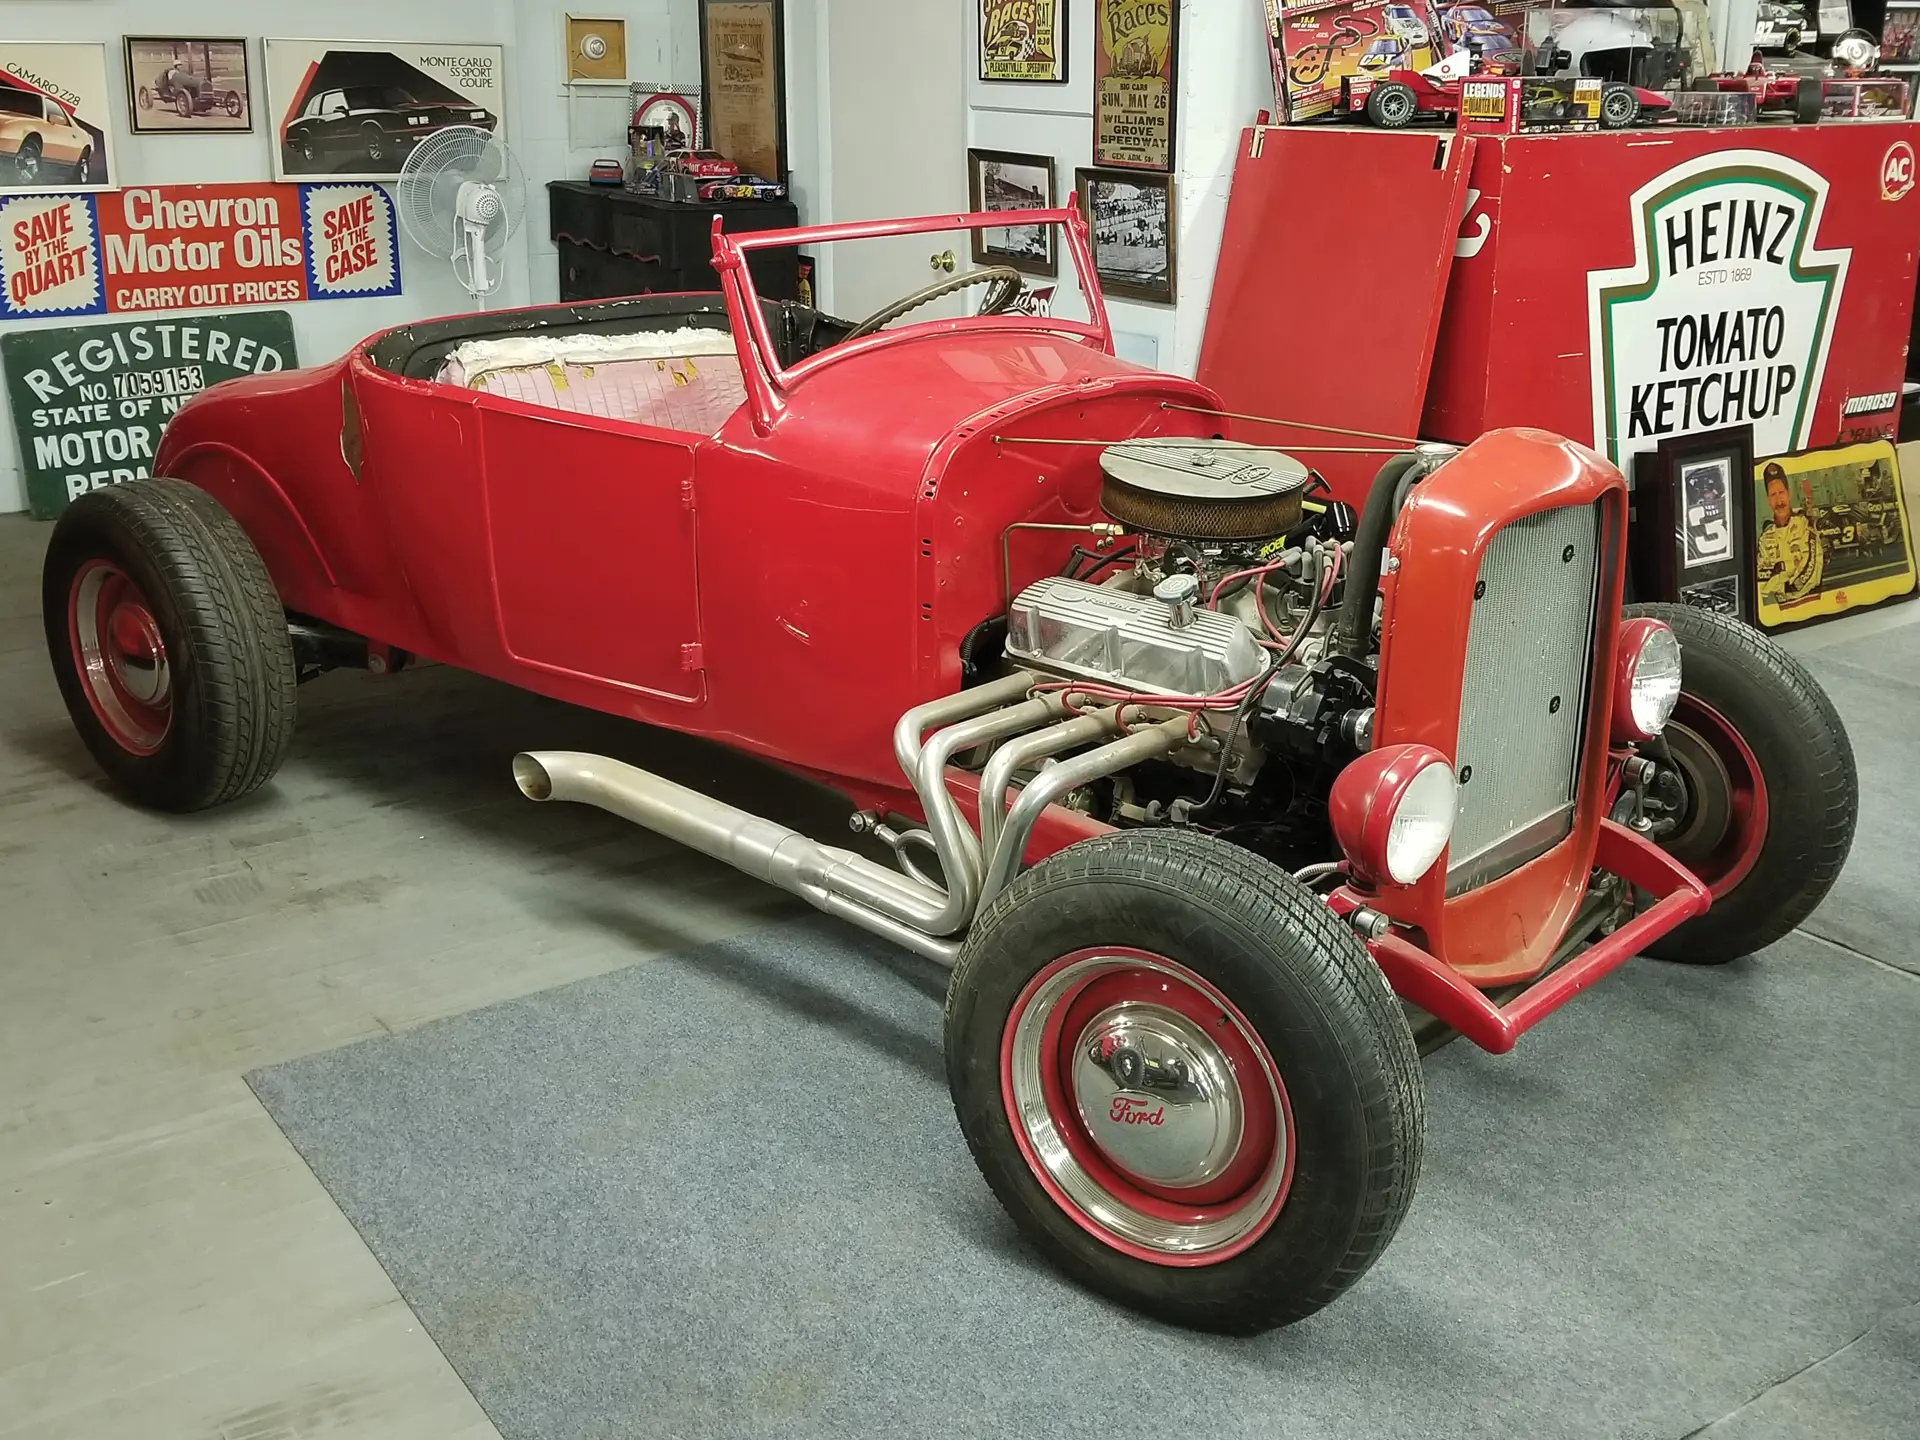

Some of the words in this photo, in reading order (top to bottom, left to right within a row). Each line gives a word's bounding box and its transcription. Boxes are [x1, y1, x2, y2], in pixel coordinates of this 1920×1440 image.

[986, 1, 1036, 46] RACES
[1037, 3, 1051, 27] SAT.
[1107, 3, 1170, 48] Races
[420, 57, 456, 67] MONTE
[458, 57, 493, 68] CARLO
[450, 67, 461, 77] SS
[461, 67, 492, 78] SPORT
[990, 62, 1023, 73] PLEASANTVILLE
[1026, 62, 1051, 74] SPEEDWAY
[1360, 54, 1397, 66] CAT
[6, 62, 59, 95] CAMARO
[59, 89, 81, 106] Z28
[459, 77, 493, 88] COUPE
[1120, 83, 1130, 91] BIG
[1463, 83, 1506, 98] LEGENDS
[1101, 92, 1124, 108] SUN.
[1128, 93, 1149, 109] MAY
[1153, 94, 1167, 109] 26
[1103, 114, 1165, 126] WILLIAMS
[1113, 125, 1154, 137] GROVE
[1100, 135, 1167, 149] SPEEDWAY
[1885, 157, 1911, 182] AC
[736, 186, 753, 198] 24
[123, 188, 280, 232] Chevron
[323, 194, 375, 240] SAVE
[13, 203, 74, 252] SAVE
[331, 233, 346, 254] BY
[347, 224, 370, 246] THE
[1664, 199, 1796, 278] HEINZ
[25, 247, 41, 267] BY
[44, 235, 69, 259] THE
[104, 232, 225, 275] Motor
[233, 227, 303, 268] Oils
[324, 237, 379, 284] CASE
[11, 245, 88, 307] QUART
[1697, 269, 1728, 286] EST'D
[1730, 266, 1753, 284] 1869
[116, 286, 185, 310] CARRY
[188, 283, 229, 305] OUT
[232, 279, 300, 303] PRICES
[1655, 304, 1786, 373] TOMATO
[23, 325, 284, 405] REGISTERED
[78, 383, 112, 403] NO.
[112, 365, 205, 399] 7059153
[31, 403, 112, 429] STATE
[119, 397, 152, 420] OF
[1626, 363, 1797, 440] KETCHUP
[1845, 391, 1898, 414] MOROSO
[33, 425, 153, 471] MOTOR
[1842, 525, 1855, 544] 3
[1109, 1096, 1165, 1126] Ford
